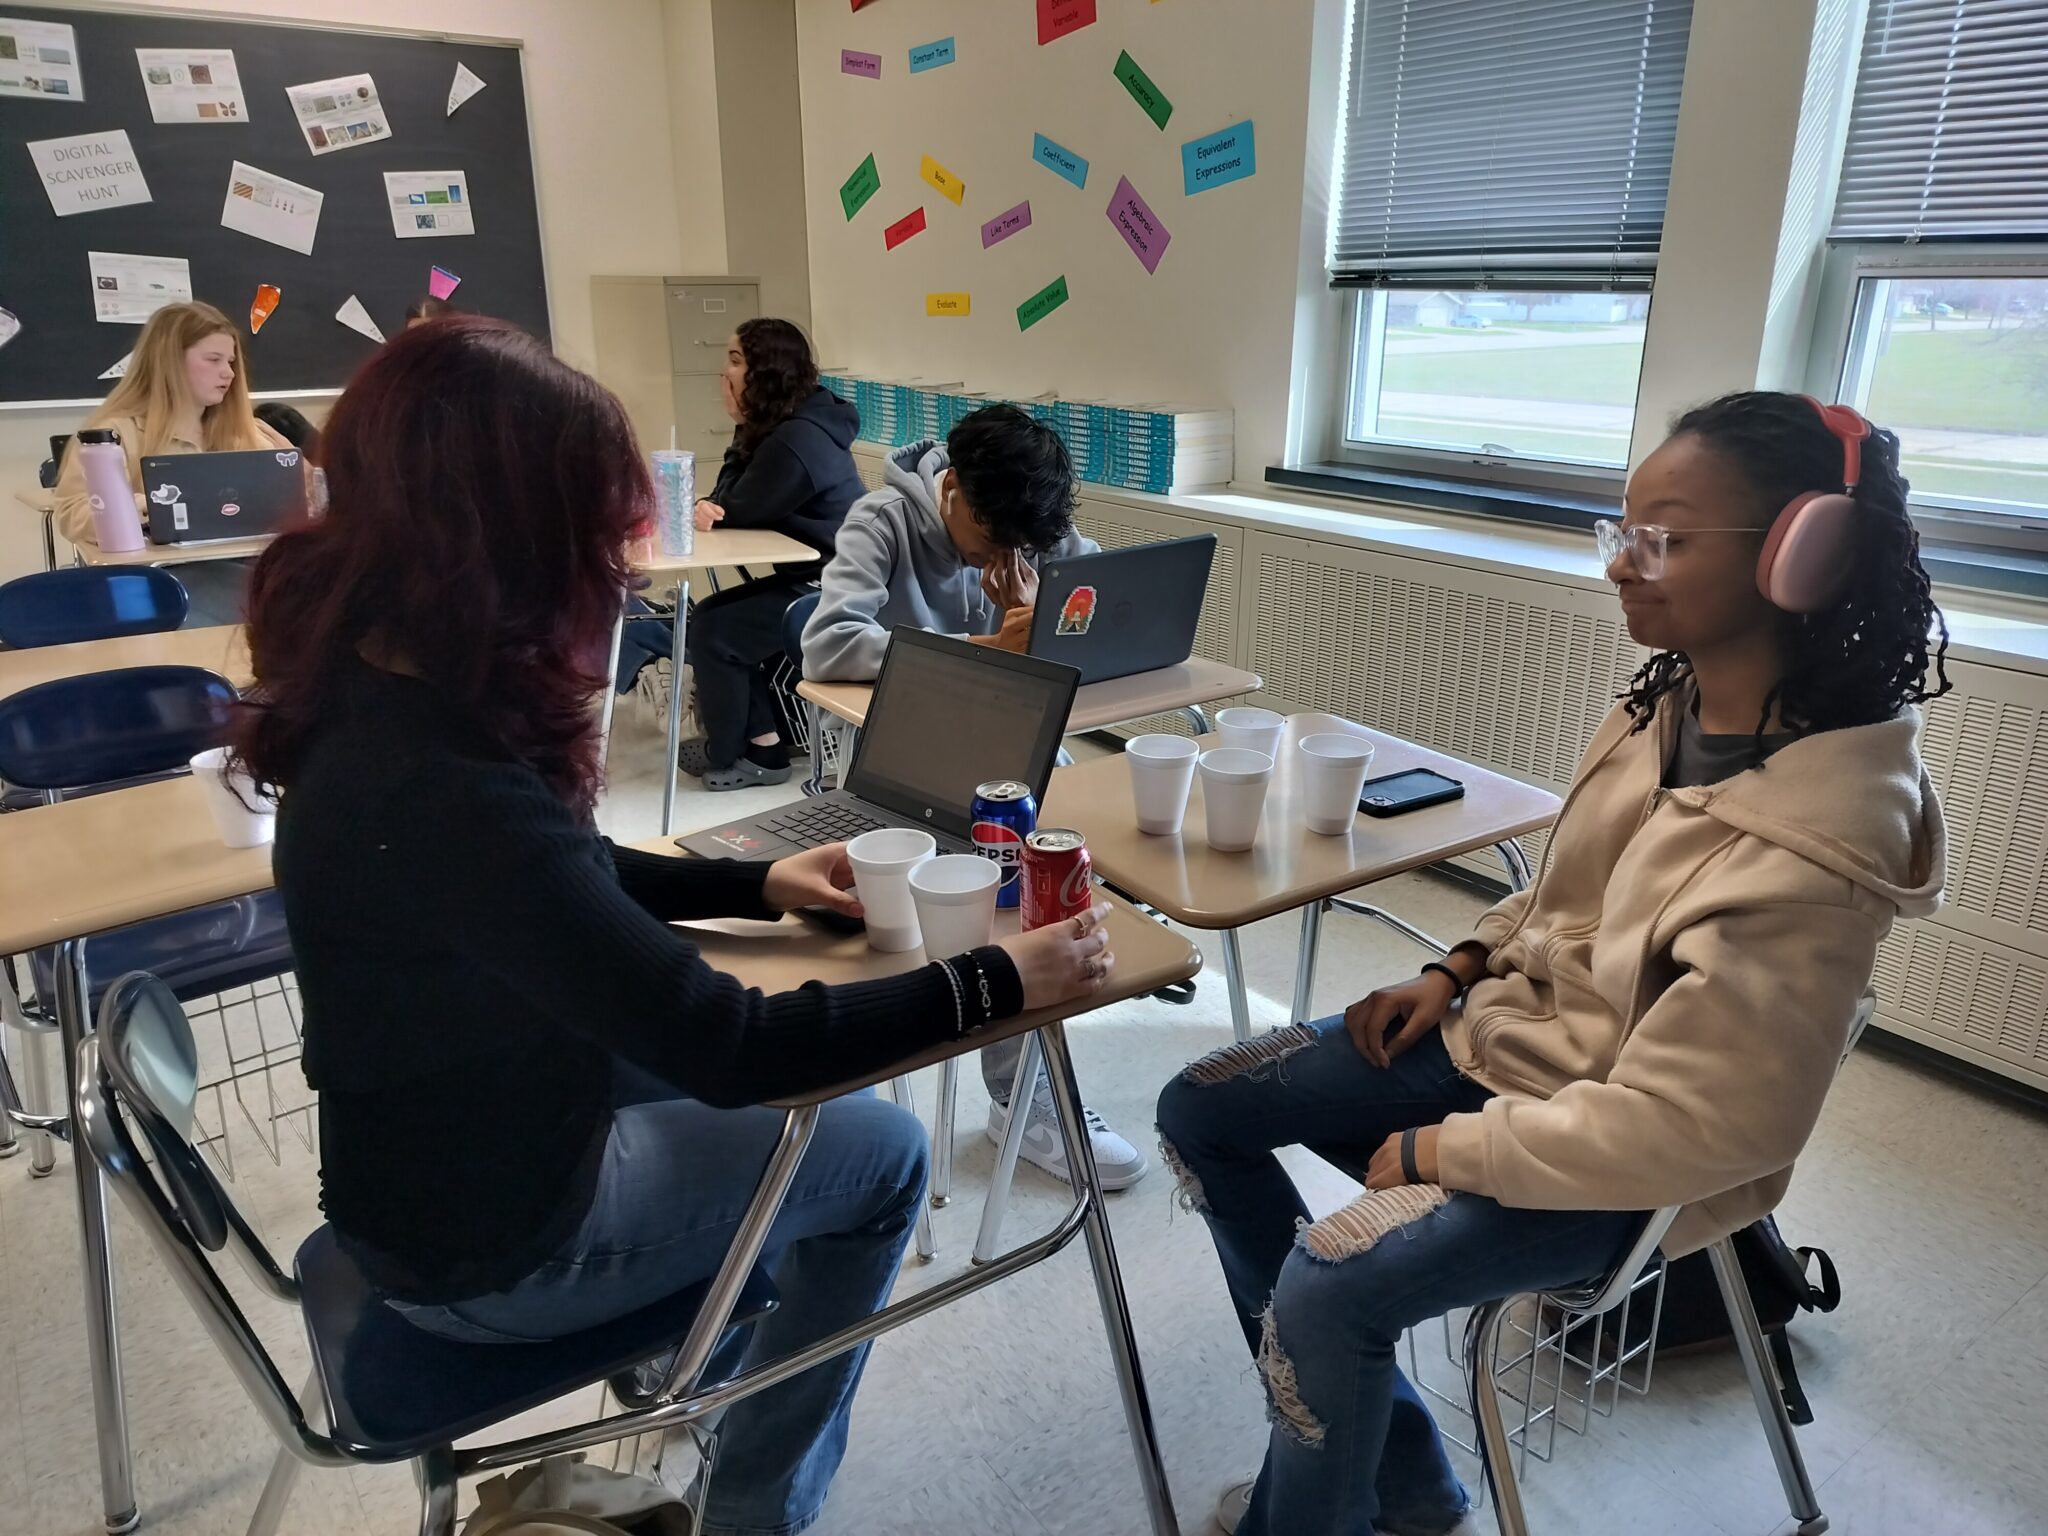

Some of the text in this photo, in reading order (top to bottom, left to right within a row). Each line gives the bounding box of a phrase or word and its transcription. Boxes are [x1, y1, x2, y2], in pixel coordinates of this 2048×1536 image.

[913, 48, 949, 65] Constant Term
[1128, 73, 1155, 109] Accuracy
[53, 143, 112, 162] DIGITAL
[1042, 146, 1076, 173] Coefficient
[1197, 137, 1236, 160] Equivalent
[46, 161, 136, 185] SCAVENGER
[1195, 157, 1241, 180] Expressions
[77, 184, 121, 202] HUNT
[990, 215, 1020, 238] Like Terms
[1127, 199, 1154, 235] Algebraic
[1118, 210, 1148, 253] Expression
